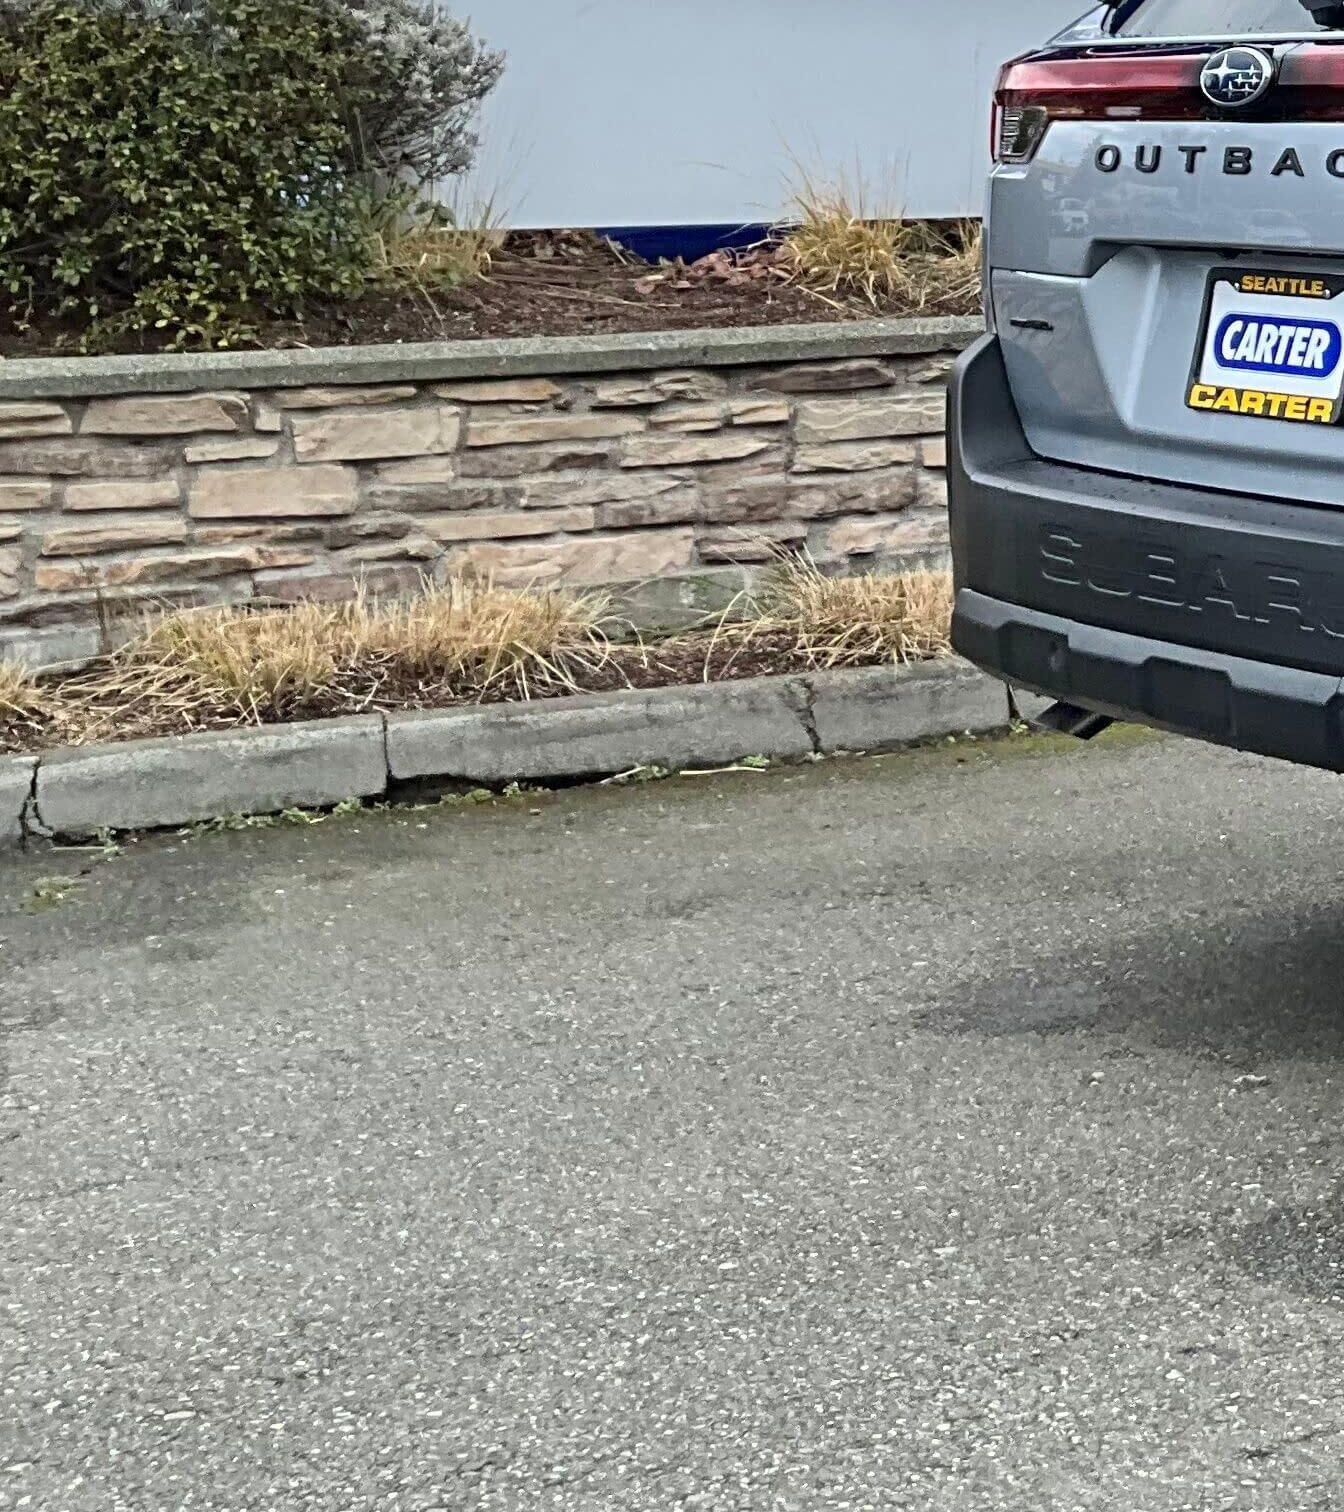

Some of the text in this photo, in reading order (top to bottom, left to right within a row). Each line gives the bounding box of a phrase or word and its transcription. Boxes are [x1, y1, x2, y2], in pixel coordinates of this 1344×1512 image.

[1241, 275, 1324, 296] SEATTLE
[1221, 320, 1331, 370] CARTER
[1189, 383, 1333, 423] CARTER
